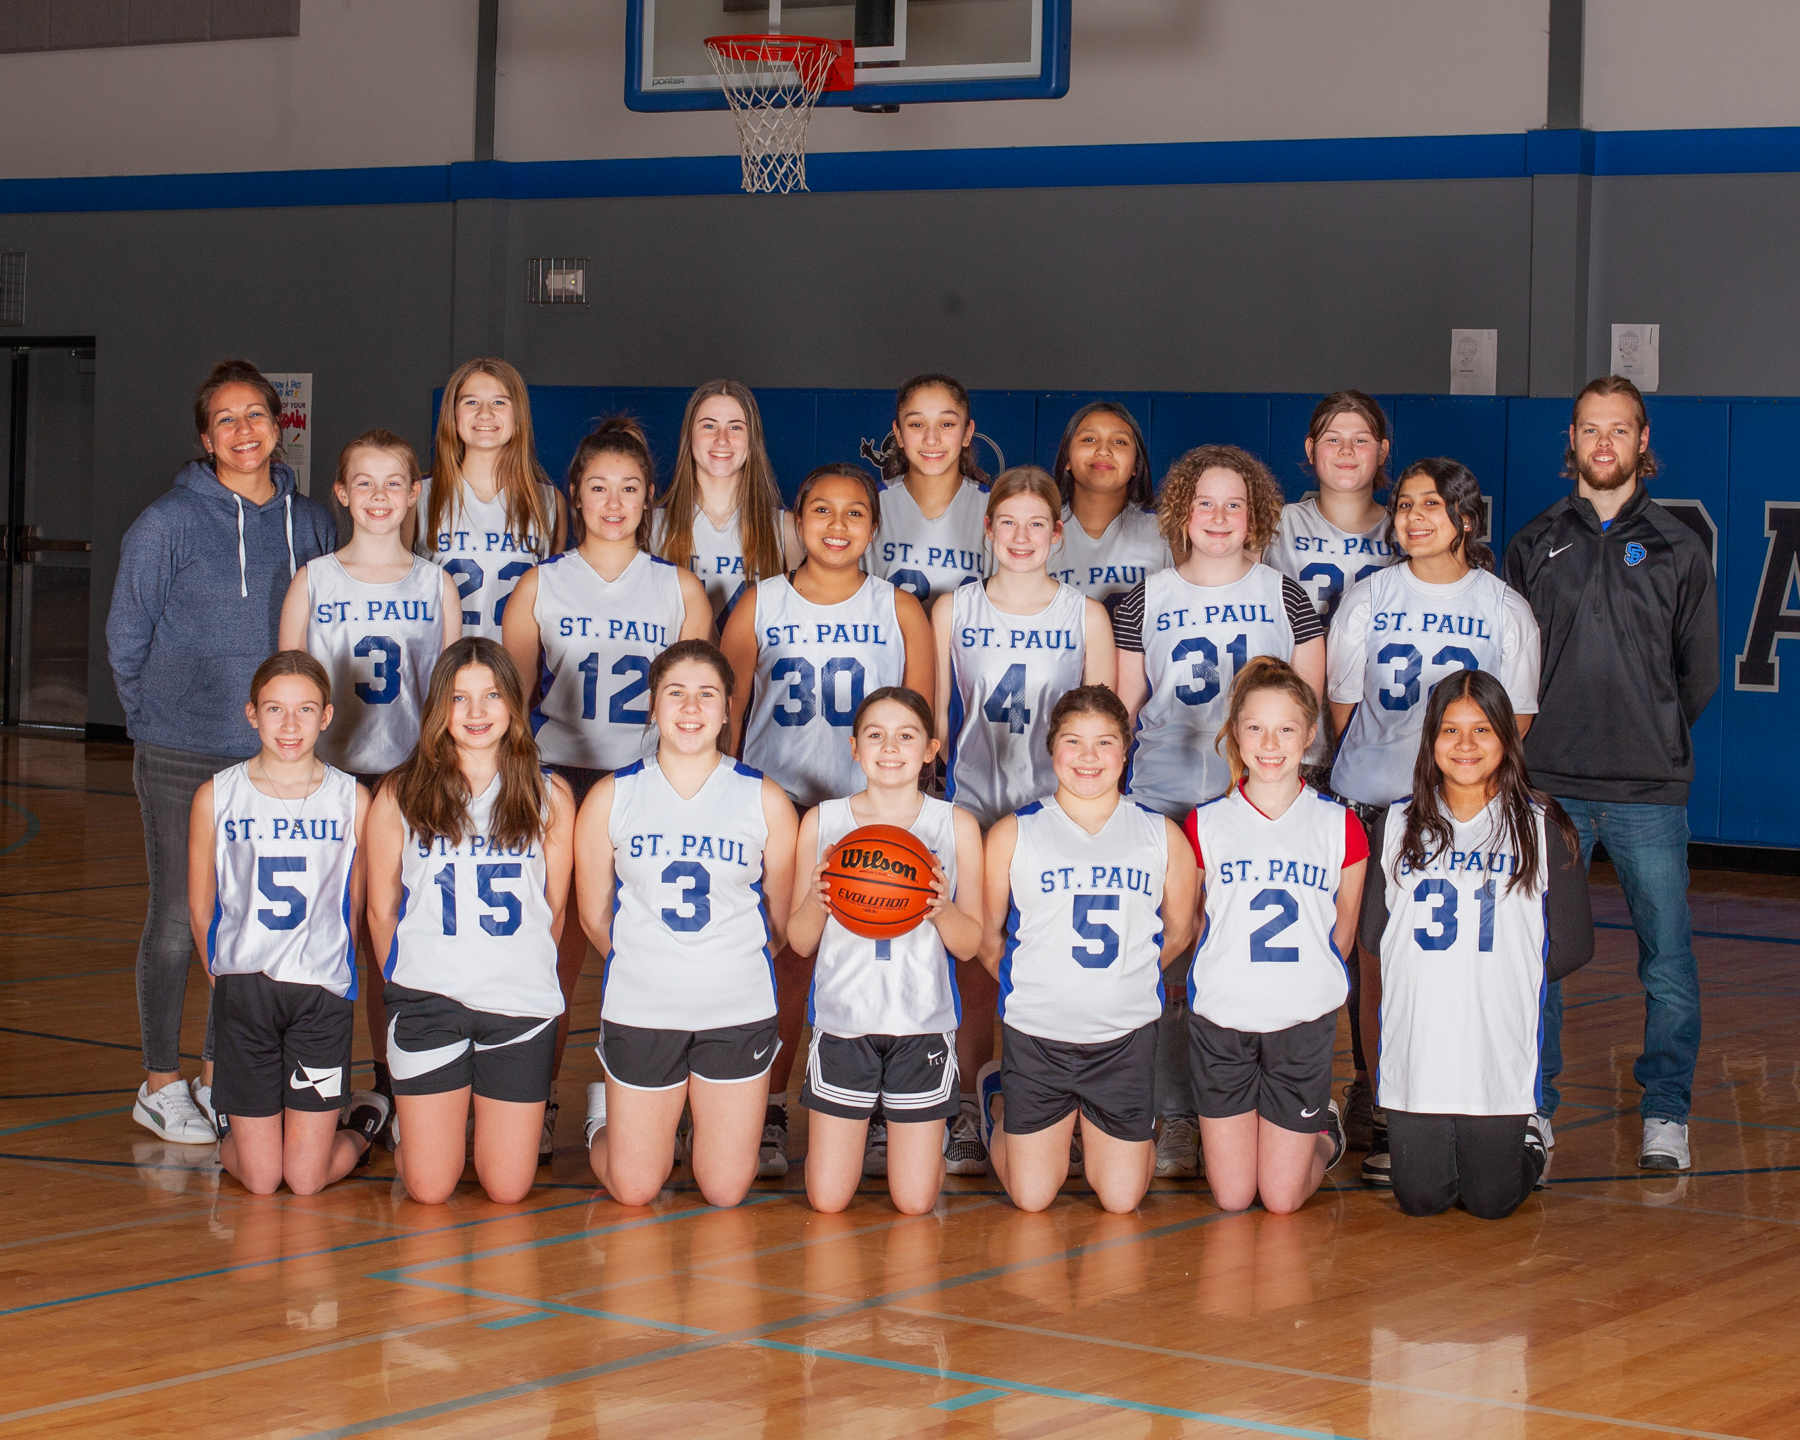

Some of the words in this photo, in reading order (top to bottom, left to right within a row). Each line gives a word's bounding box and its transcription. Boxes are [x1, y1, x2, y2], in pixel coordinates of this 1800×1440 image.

[438, 531, 477, 552] ST.
[1295, 536, 1335, 554] ST.
[716, 556, 760, 576] PA
[883, 542, 919, 564] ST.
[927, 547, 984, 574] PAUL
[1299, 562, 1386, 628] 3
[317, 601, 359, 624] ST.
[367, 600, 434, 622] PAUL
[1157, 608, 1198, 631] ST.
[1205, 604, 1275, 624] PAUL
[1373, 612, 1413, 632] ST.
[1421, 613, 1491, 640] PAUL
[560, 617, 601, 638] ST.
[609, 619, 669, 649] PAUL
[766, 625, 808, 647] ST.
[817, 624, 887, 645] PAUL
[962, 628, 1001, 648] ST.
[1010, 630, 1076, 650] PAUL
[353, 635, 402, 705] 3
[1171, 634, 1249, 706] 31
[578, 652, 653, 725] 12
[771, 656, 866, 727] 30
[983, 663, 1031, 734] 4
[224, 819, 264, 841] ST.
[273, 818, 344, 841] PAUL
[418, 834, 460, 858] ST.
[630, 834, 671, 857] ST.
[681, 835, 749, 866] PAUL
[841, 849, 917, 882] Wilson
[1041, 866, 1082, 893] ST.
[1091, 866, 1153, 897] PAUL
[1220, 860, 1259, 885] ST.
[1268, 860, 1330, 892] PAUL
[257, 856, 308, 931] 5
[434, 863, 523, 937] 15
[661, 860, 711, 932] 3
[838, 887, 910, 908] EVOLUTION
[1071, 894, 1120, 969] 5
[1249, 888, 1300, 963] 2
[1413, 878, 1497, 953] 31
